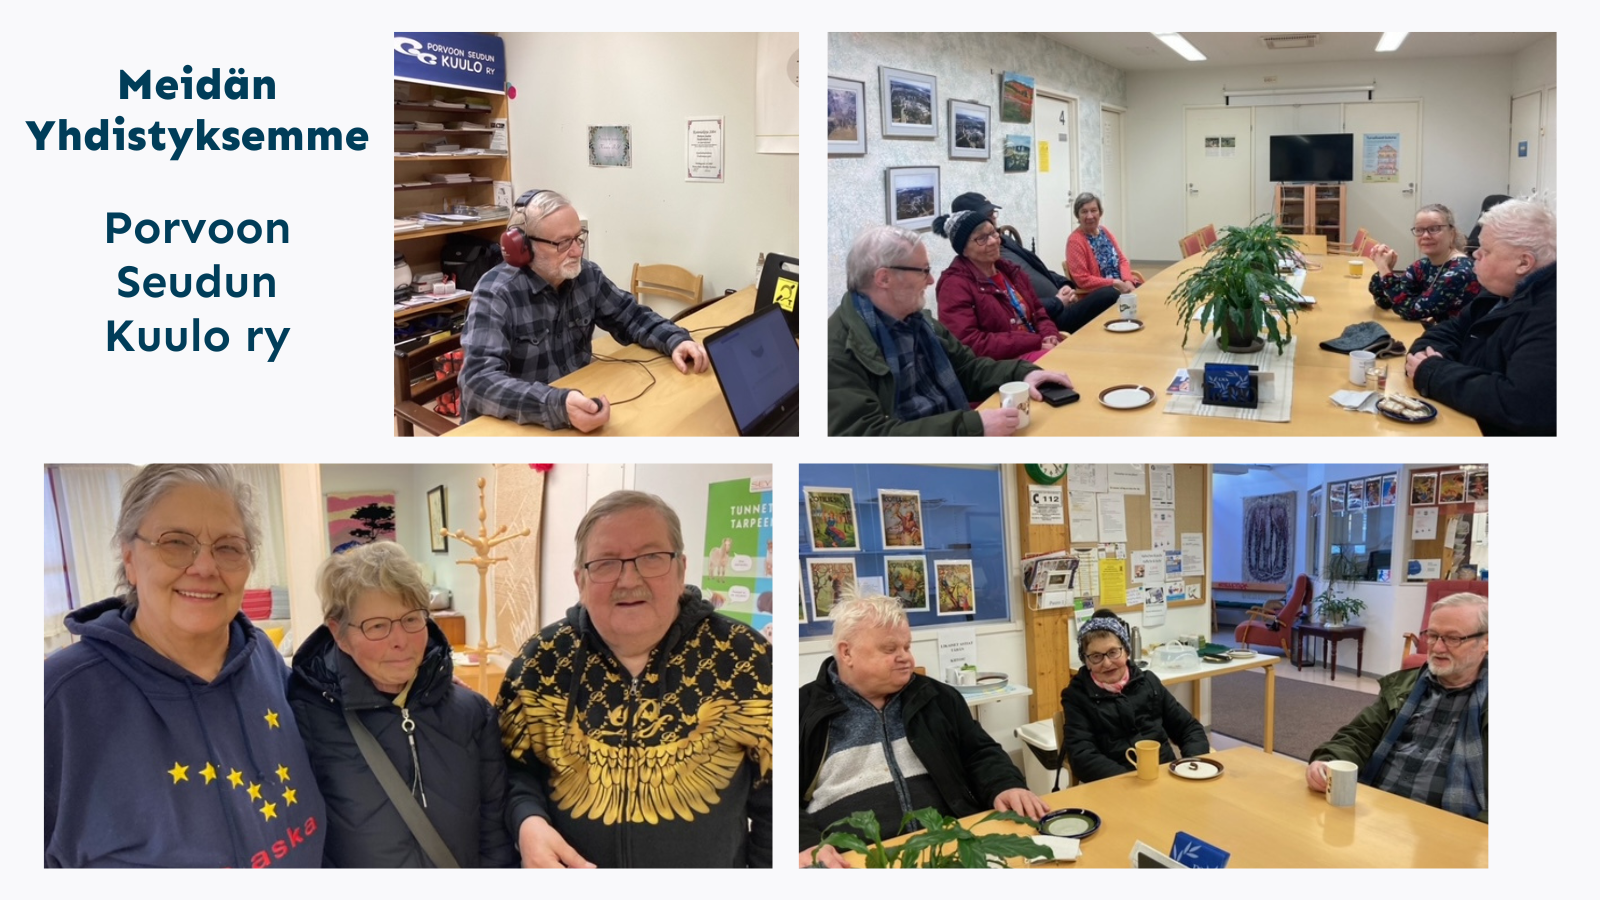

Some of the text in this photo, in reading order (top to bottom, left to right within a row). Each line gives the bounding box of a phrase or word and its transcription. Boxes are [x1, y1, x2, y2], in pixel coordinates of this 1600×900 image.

[427, 43, 495, 62] PORVOON SEUDUN
[441, 55, 496, 75] KUULO RY
[1059, 110, 1065, 126] 4
[1042, 495, 1060, 503] 112
[730, 503, 772, 516] TUNNET
[250, 816, 318, 869] aska
